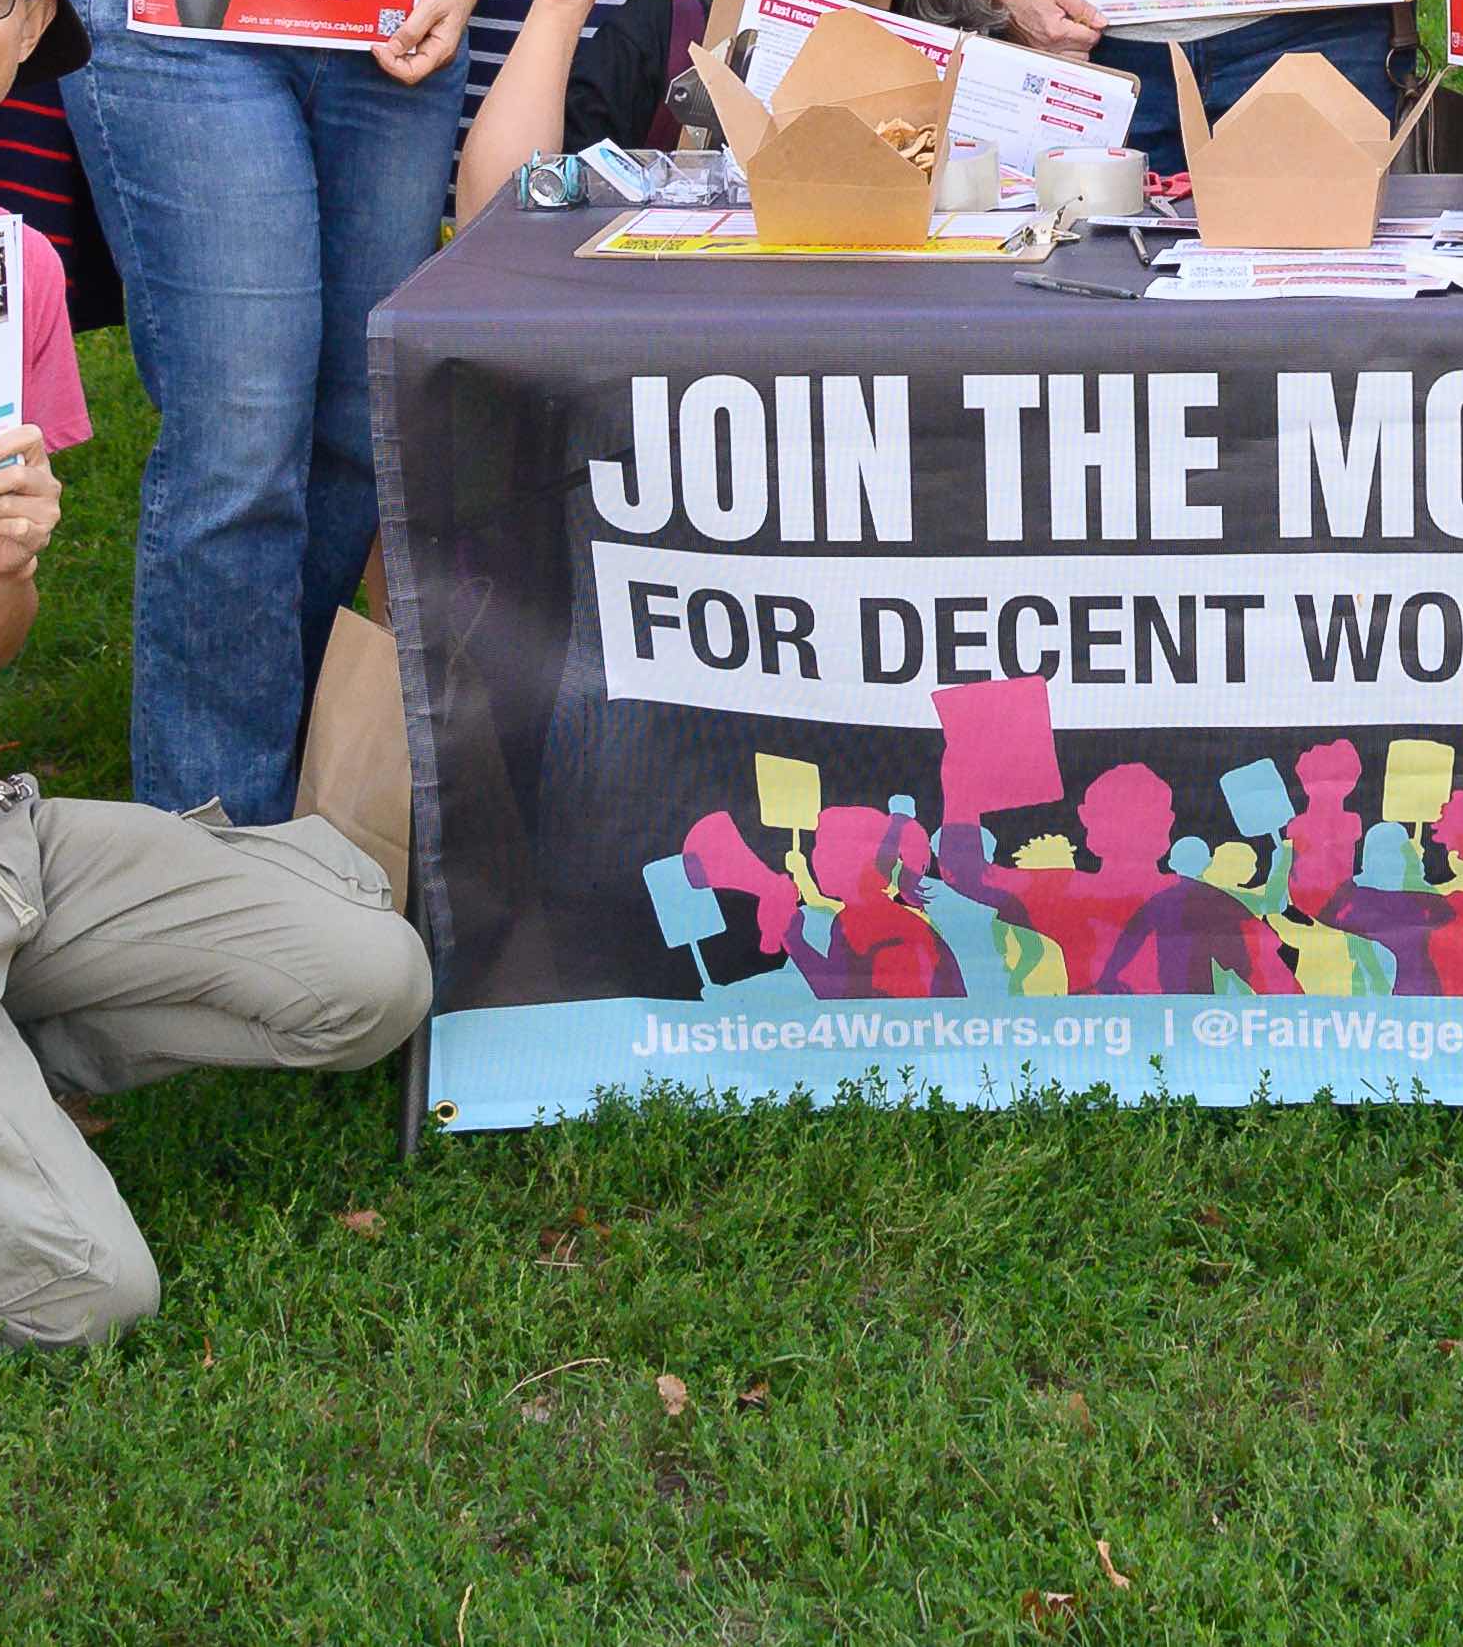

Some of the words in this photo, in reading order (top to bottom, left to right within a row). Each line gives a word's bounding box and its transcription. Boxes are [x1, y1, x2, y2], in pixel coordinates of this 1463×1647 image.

[763, 0, 772, 12] A
[772, 3, 791, 19] just
[589, 374, 913, 543] JOIN
[962, 373, 1224, 542] THE
[628, 579, 822, 681] FOR
[859, 594, 1265, 685] DECENT
[632, 1010, 1133, 1058] Justice4Workers.org
